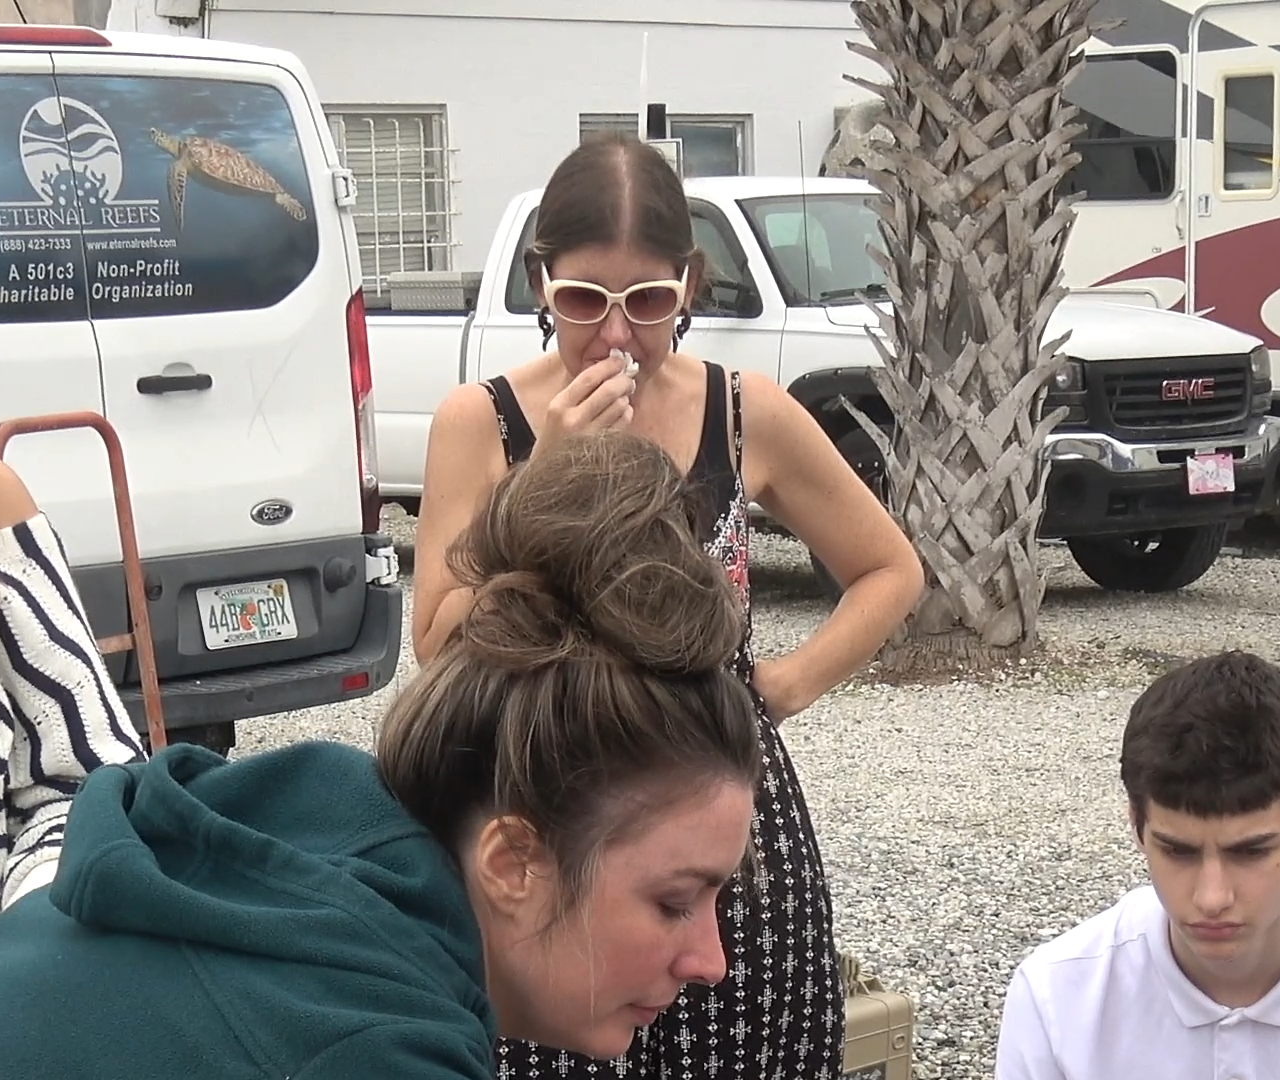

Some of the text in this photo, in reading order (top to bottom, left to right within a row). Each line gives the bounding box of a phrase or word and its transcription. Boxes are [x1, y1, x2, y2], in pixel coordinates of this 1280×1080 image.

[101, 206, 161, 228] REEFS
[0, 236, 177, 254] (888) 423-7333 www.eternalreefs.com
[8, 259, 181, 281] A 501c3 Non-Profit
[91, 280, 193, 303] Organization
[1162, 378, 1215, 401] GMC
[262, 505, 286, 520] Ford
